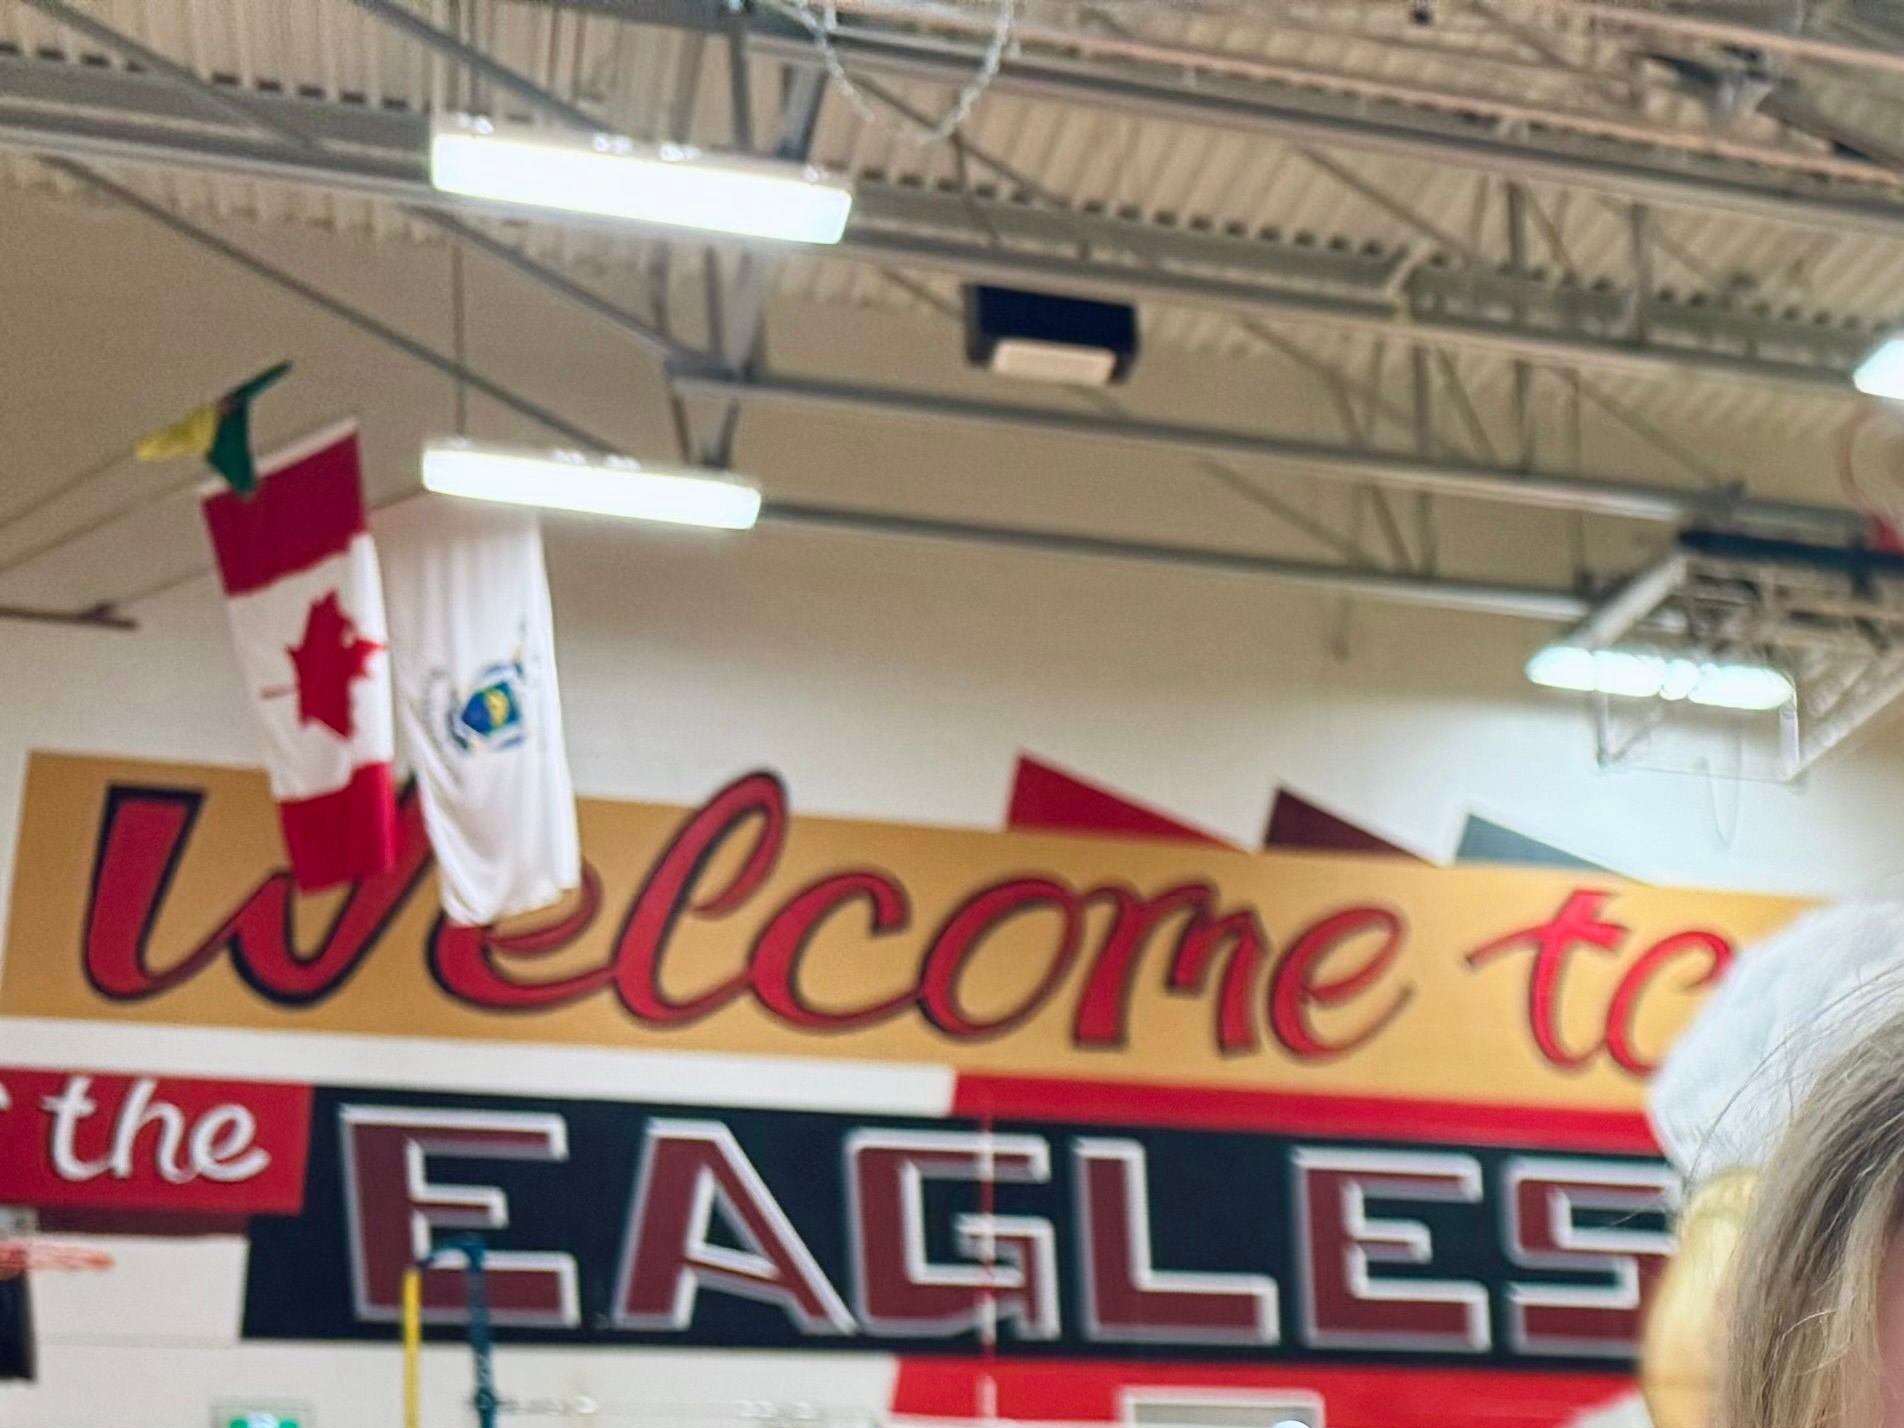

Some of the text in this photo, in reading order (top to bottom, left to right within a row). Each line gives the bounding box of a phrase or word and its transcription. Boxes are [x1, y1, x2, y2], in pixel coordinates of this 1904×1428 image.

[80, 768, 1412, 1062] Welcome
[40, 1075, 272, 1186] the
[338, 1102, 1684, 1358] EAGLES
